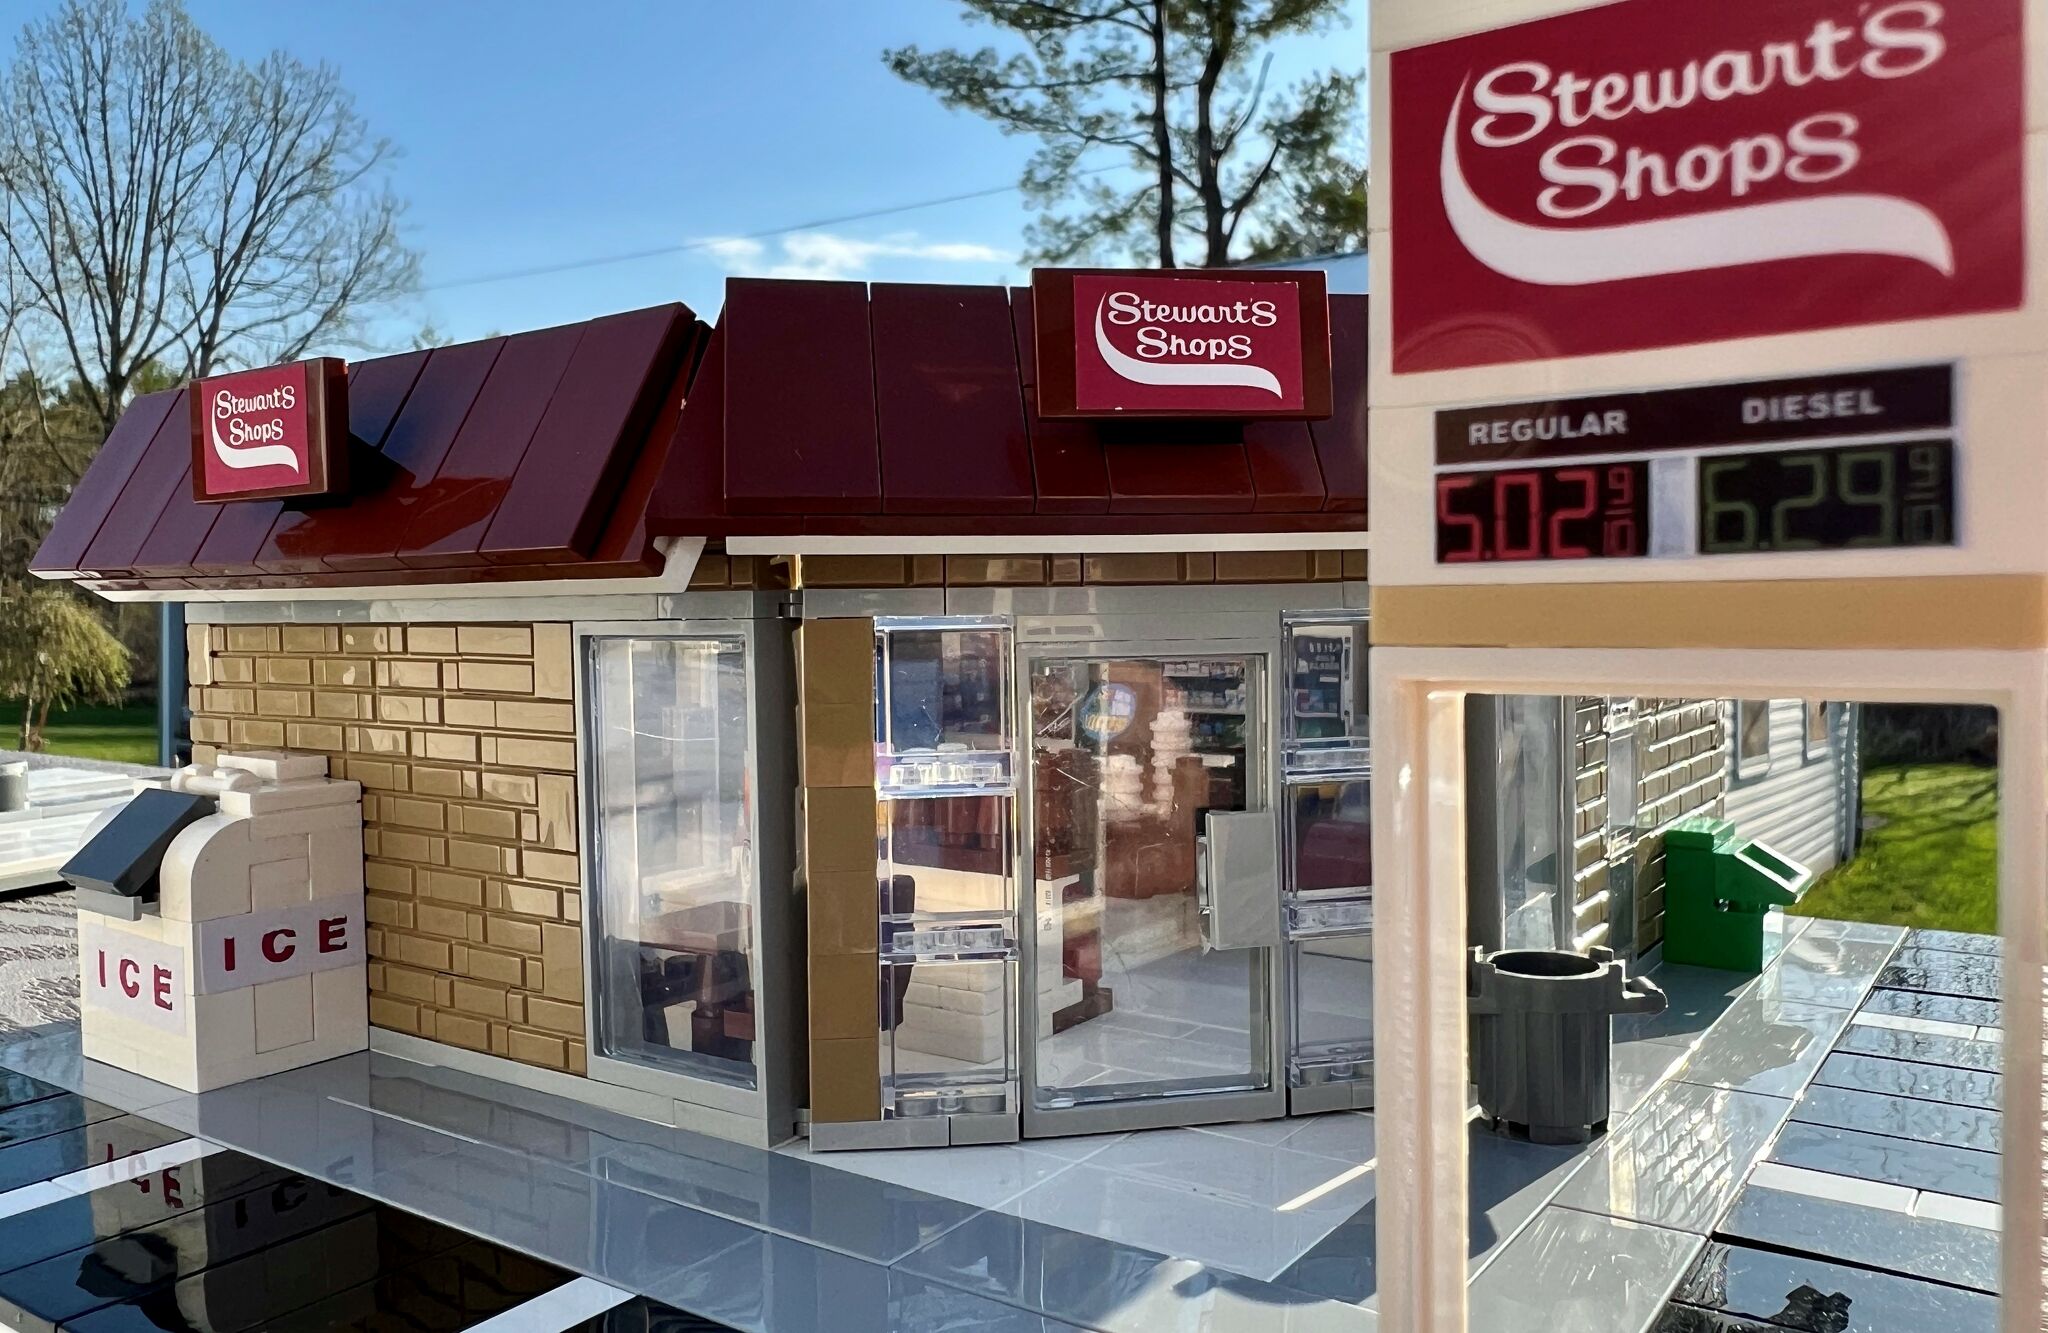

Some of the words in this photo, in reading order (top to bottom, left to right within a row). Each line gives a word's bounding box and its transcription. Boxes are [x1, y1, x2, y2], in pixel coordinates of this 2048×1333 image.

[1468, 409, 1629, 446] REGULAR
[1741, 389, 1886, 424] DIESEL
[222, 914, 349, 972] ICE
[98, 948, 174, 1011] ICE
